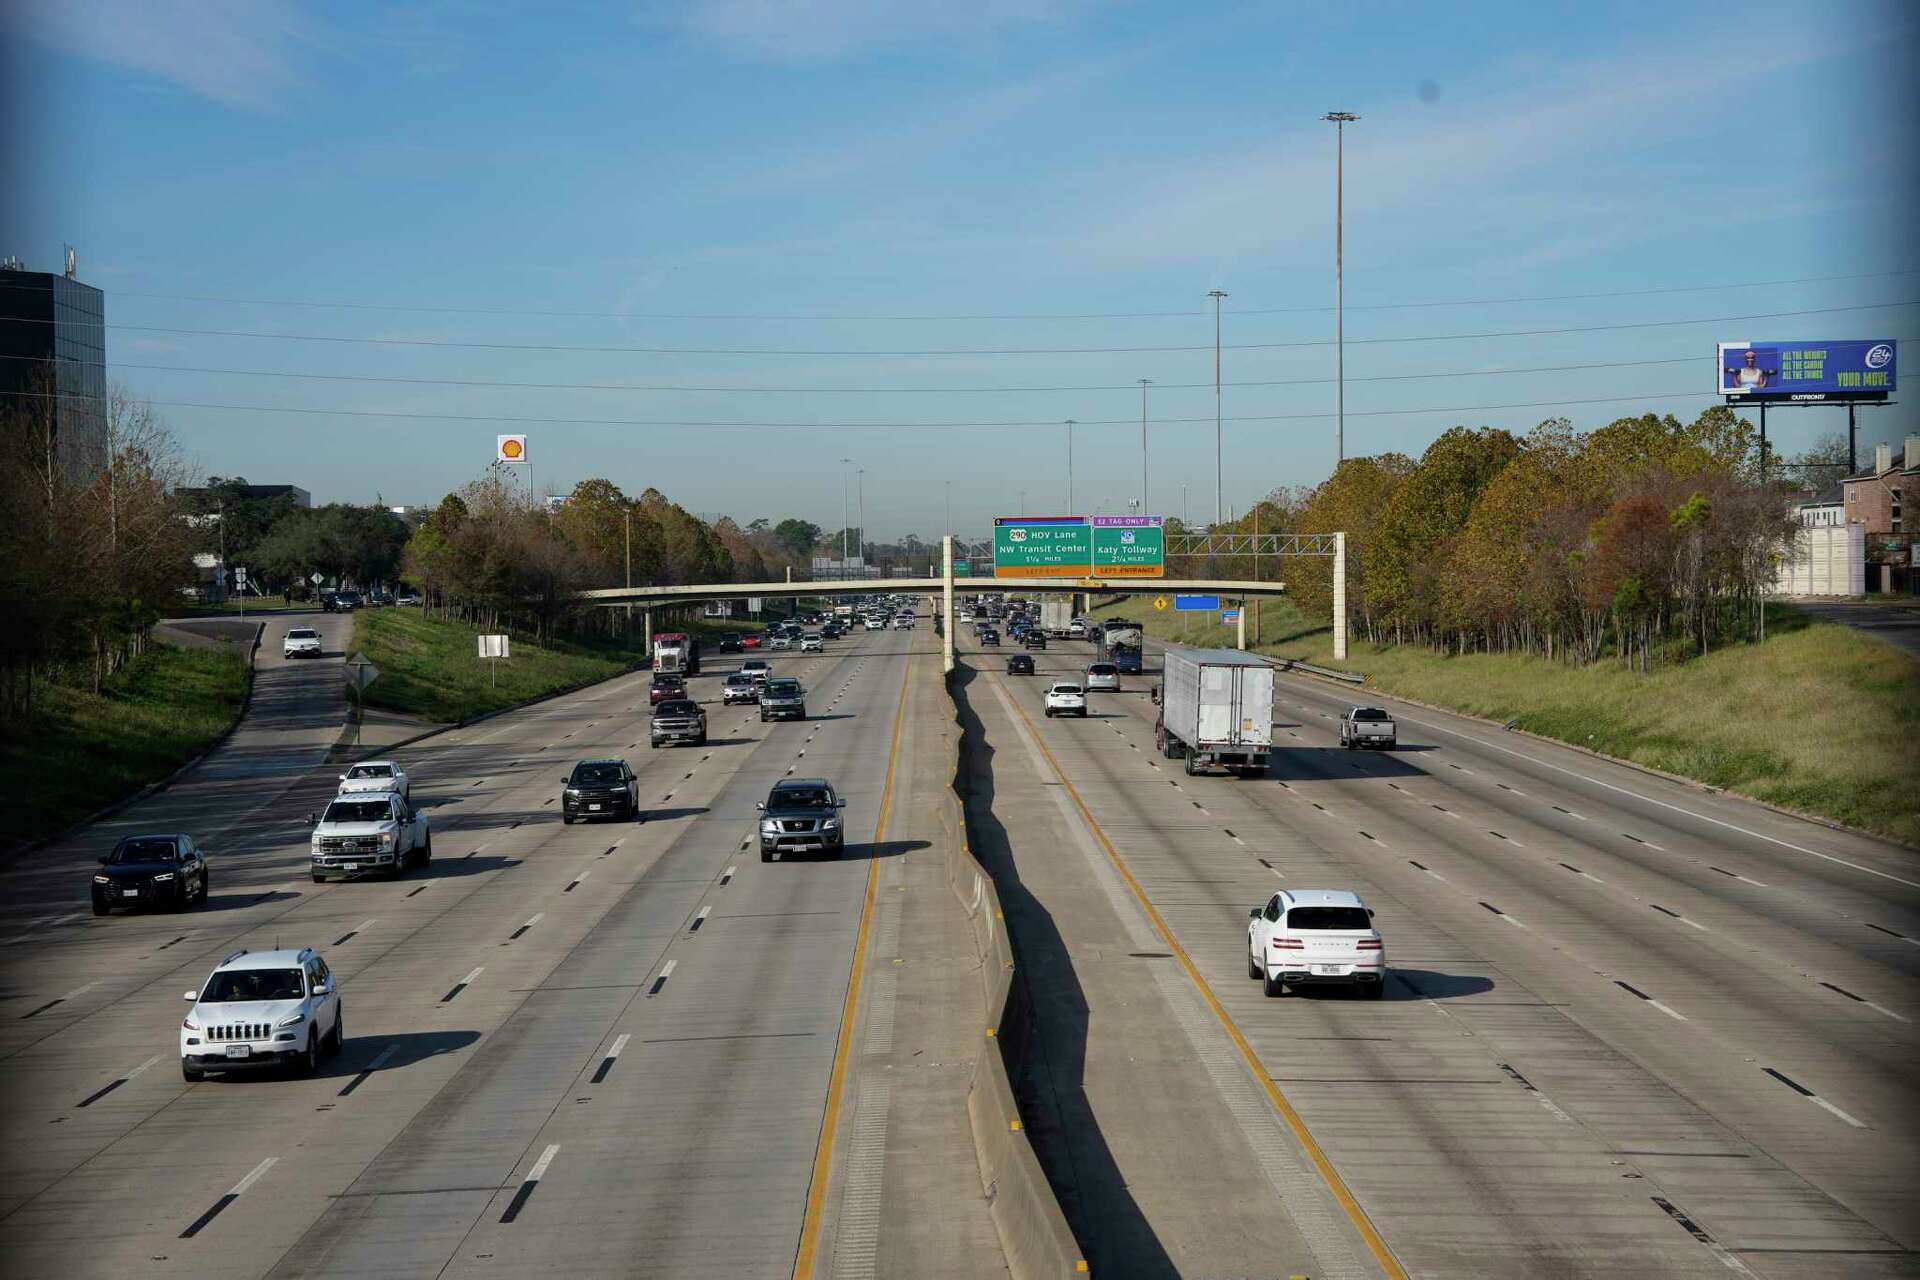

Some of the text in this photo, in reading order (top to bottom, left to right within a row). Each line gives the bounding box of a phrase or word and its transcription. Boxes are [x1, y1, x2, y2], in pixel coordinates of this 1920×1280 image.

[1837, 372, 1860, 387] YOUR
[1011, 531, 1026, 539] 290
[1055, 531, 1077, 539] Lane
[1019, 545, 1051, 553] Transit
[1056, 545, 1087, 553] Center
[1098, 546, 1157, 555] Katy Tollway
